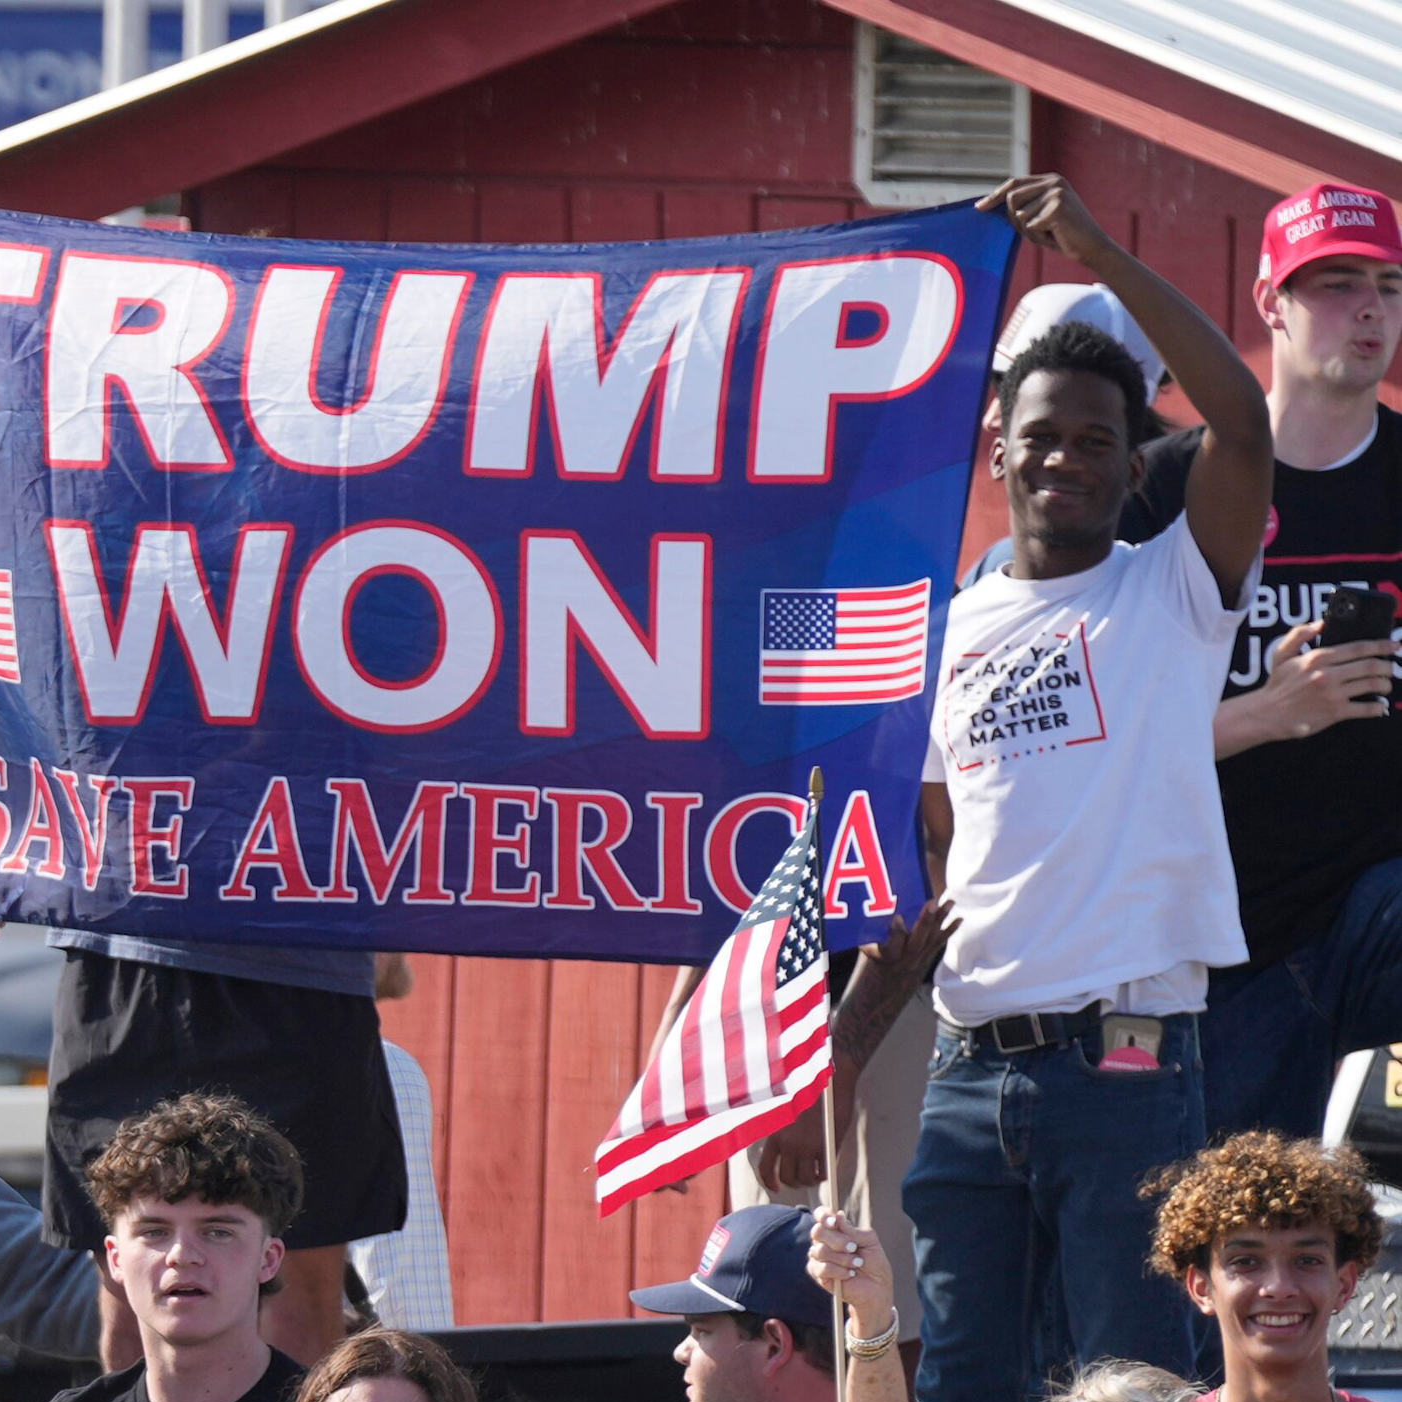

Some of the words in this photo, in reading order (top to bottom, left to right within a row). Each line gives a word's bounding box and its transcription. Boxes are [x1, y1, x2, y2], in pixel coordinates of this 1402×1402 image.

[1277, 198, 1312, 227] MAKE
[1317, 191, 1378, 210] AMERICA
[1286, 214, 1326, 244] GREAT
[1332, 210, 1376, 227] AGAIN
[45, 519, 711, 739] WON
[970, 709, 996, 728] TO
[1006, 694, 1062, 718] THIS
[969, 712, 1070, 747] MATTER
[219, 775, 896, 918] AMERICA
